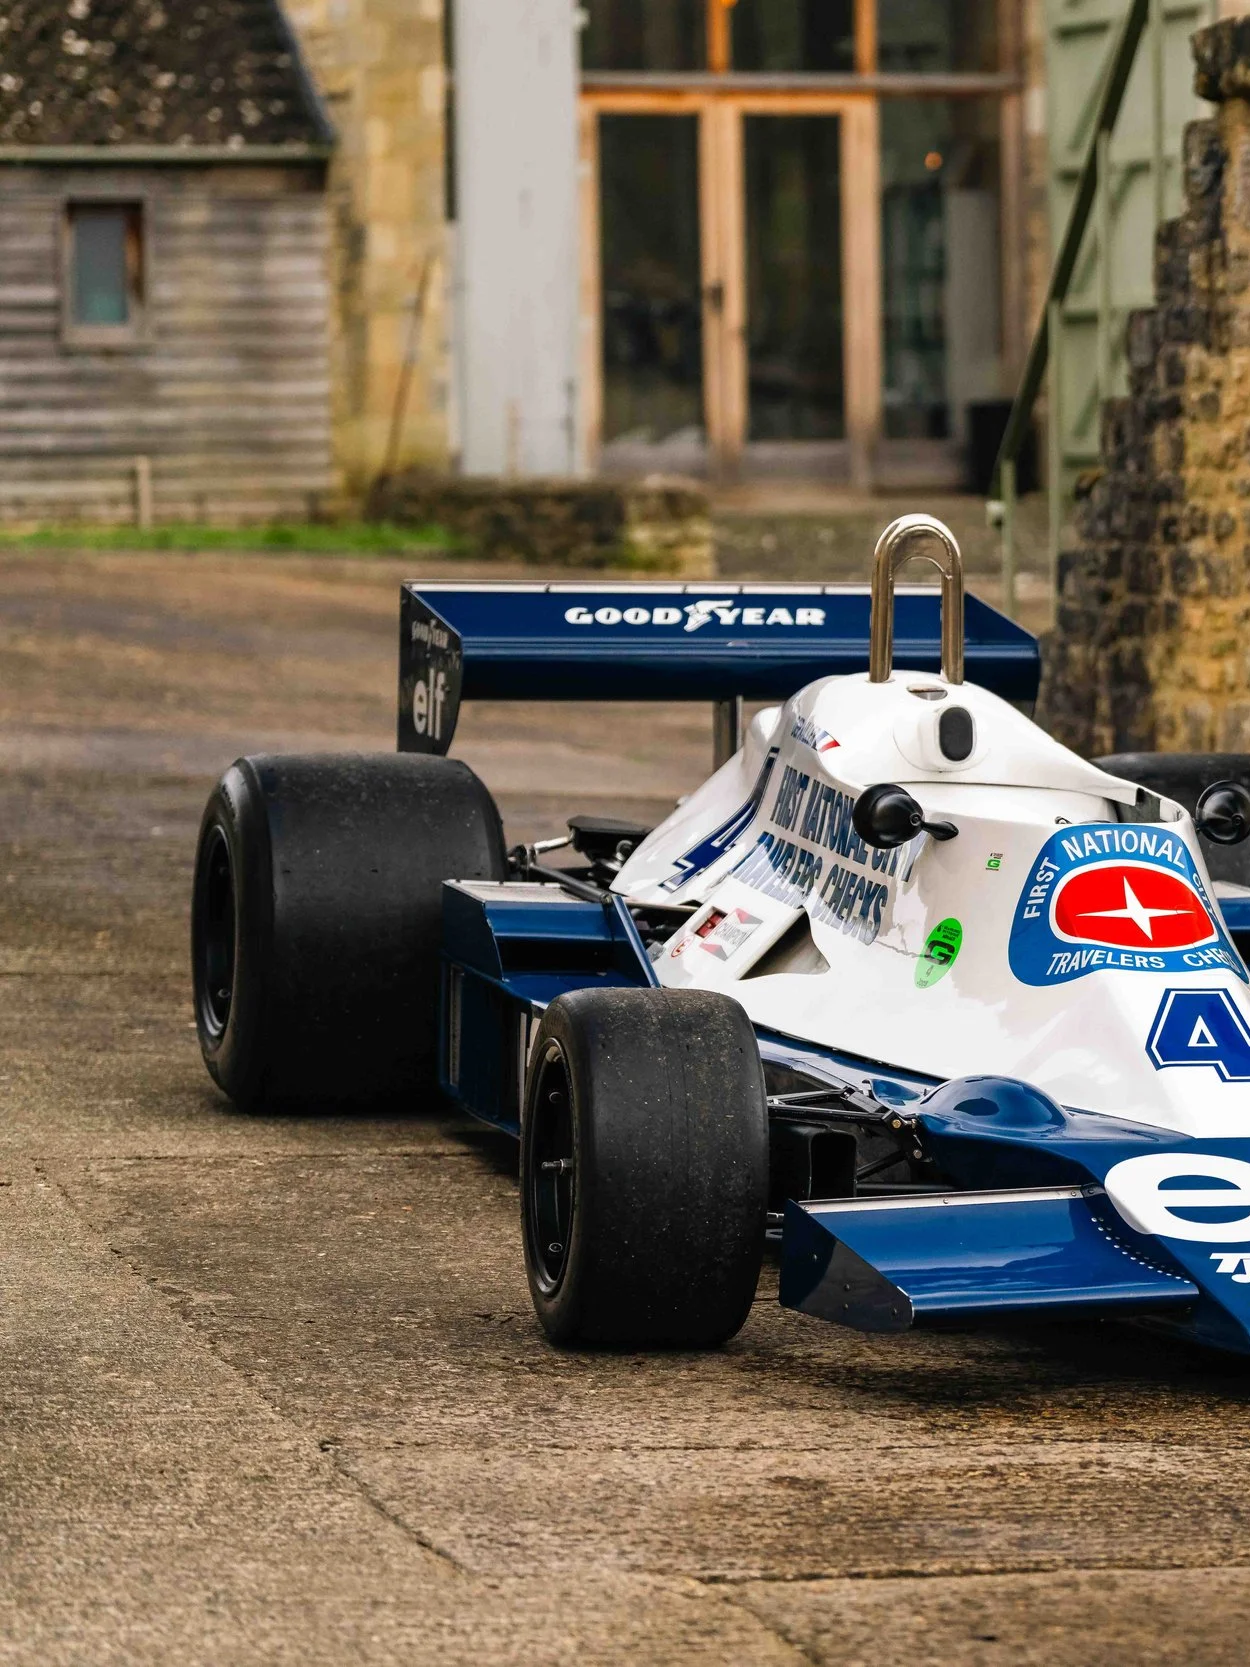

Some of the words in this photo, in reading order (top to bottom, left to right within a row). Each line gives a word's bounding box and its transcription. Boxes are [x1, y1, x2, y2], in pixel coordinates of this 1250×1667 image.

[565, 600, 825, 632] GOODYEAR
[413, 667, 447, 741] elf
[658, 746, 780, 893] 4
[810, 864, 889, 945] CHECKS
[1023, 856, 1061, 919] FIRST
[1061, 829, 1186, 868] NATIONAL
[1045, 949, 1166, 975] TRAVELERS
